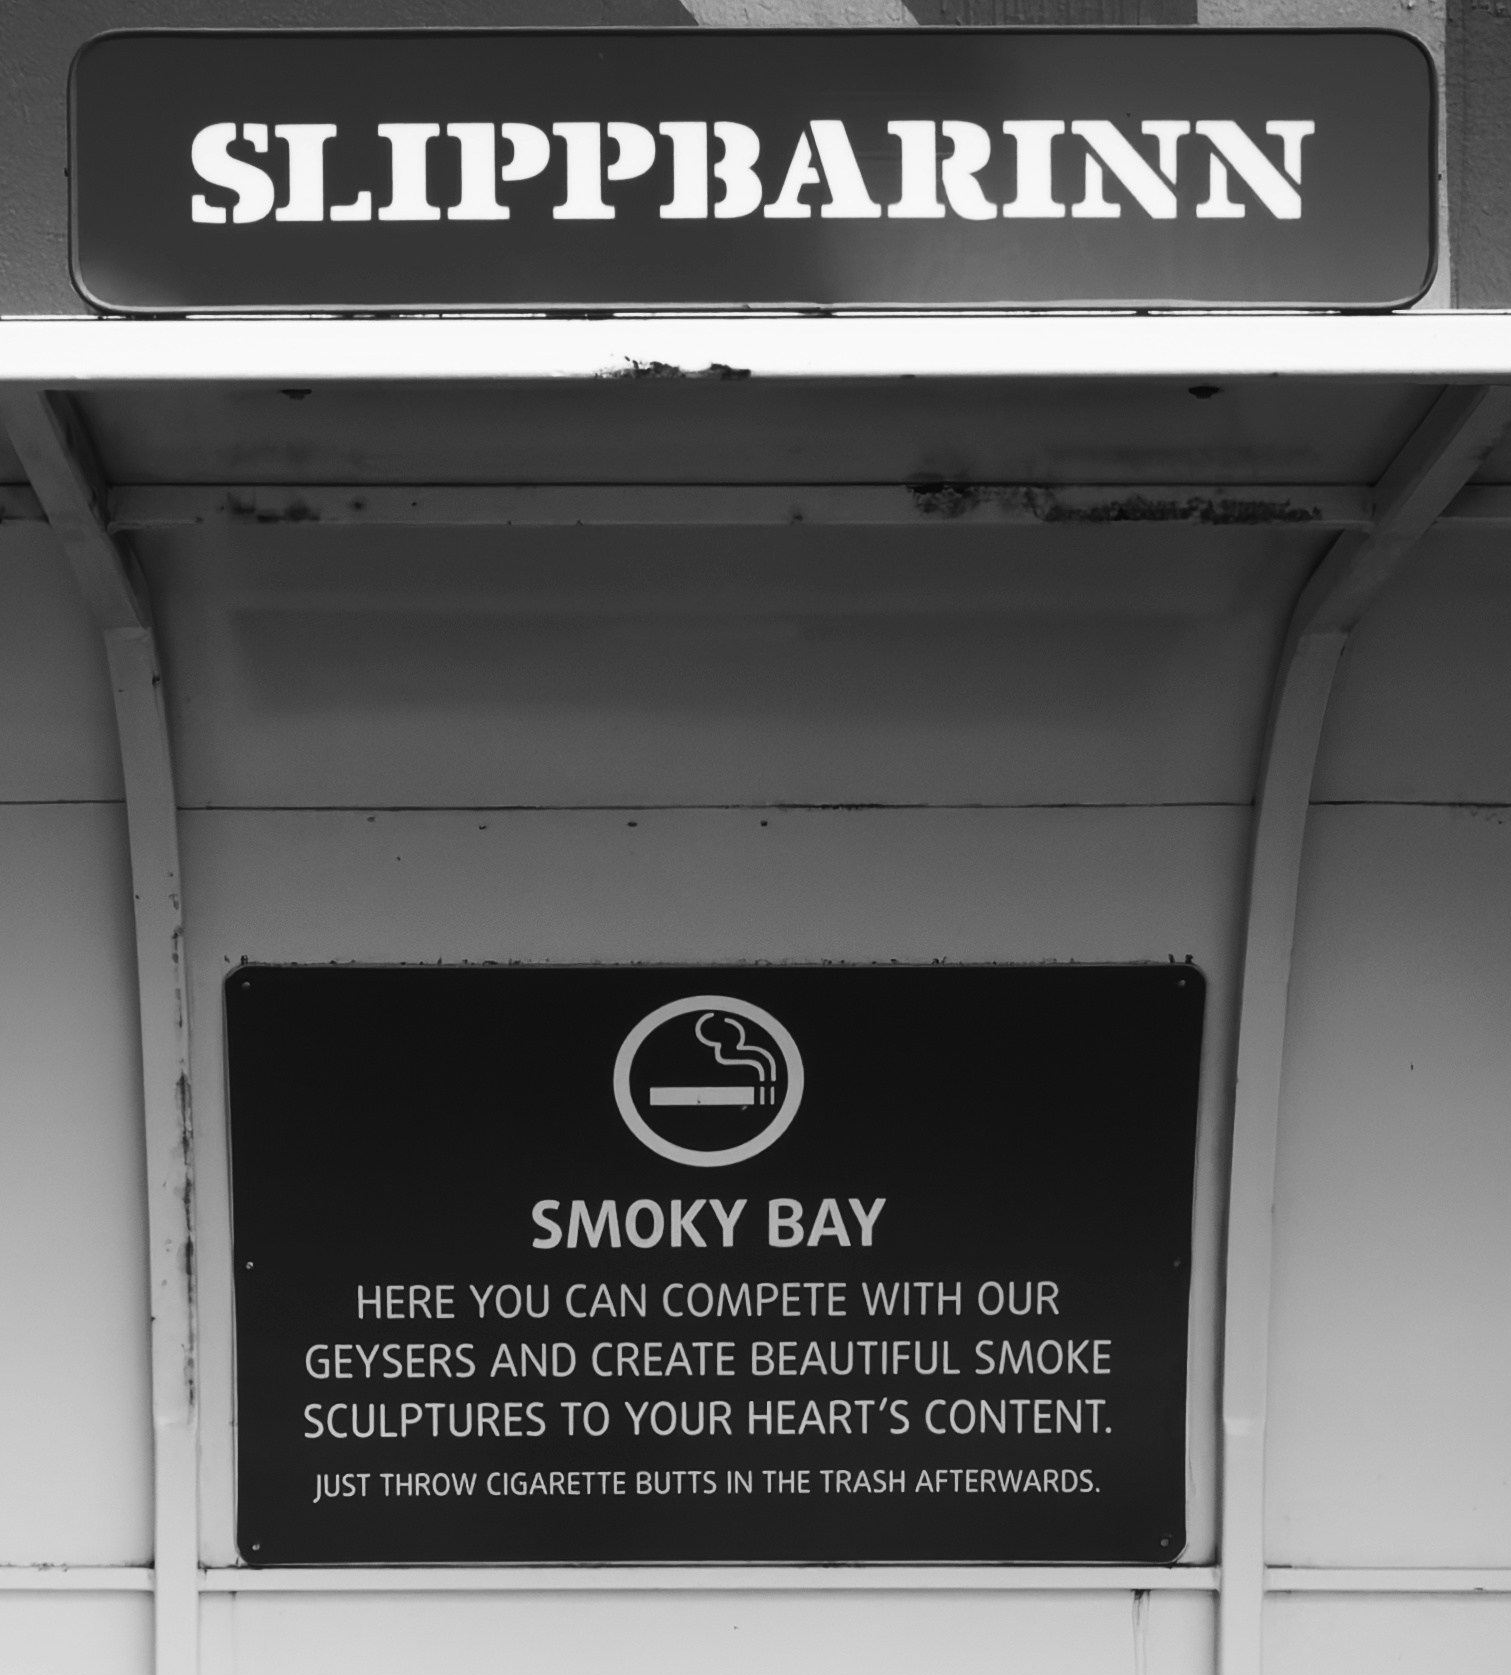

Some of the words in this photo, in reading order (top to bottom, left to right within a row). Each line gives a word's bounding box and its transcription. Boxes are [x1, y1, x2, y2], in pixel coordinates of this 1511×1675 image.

[191, 119, 1315, 224] SLIPPBARINN
[531, 1198, 748, 1250] SMOKY
[768, 1197, 887, 1248] BAY
[357, 1284, 456, 1320] HERE
[468, 1283, 550, 1319] YOU
[565, 1283, 647, 1319] CAN
[662, 1281, 847, 1318] COMPETE
[861, 1281, 962, 1317] WITH
[977, 1280, 1060, 1316] OUR
[305, 1342, 476, 1380] GEYSERS
[489, 1342, 577, 1378] AND
[591, 1341, 736, 1378] CREATE
[751, 1340, 961, 1377] BEAUTIFUL
[974, 1339, 1112, 1376] SMOKE
[303, 1401, 547, 1439] SCULPTURES
[560, 1401, 610, 1437] TO
[624, 1400, 733, 1437] YOUR
[748, 1396, 910, 1436] HEART'S
[924, 1398, 1112, 1435] CONTENT.
[312, 1472, 371, 1504] JUST
[379, 1472, 478, 1497] THROW
[486, 1471, 627, 1496] CIGARETTE
[635, 1470, 718, 1495] BUTTS
[726, 1469, 753, 1495] IN
[761, 1469, 811, 1494] THE
[819, 1469, 906, 1494] TRASH
[914, 1468, 1101, 1494] AFTERWARDS.
